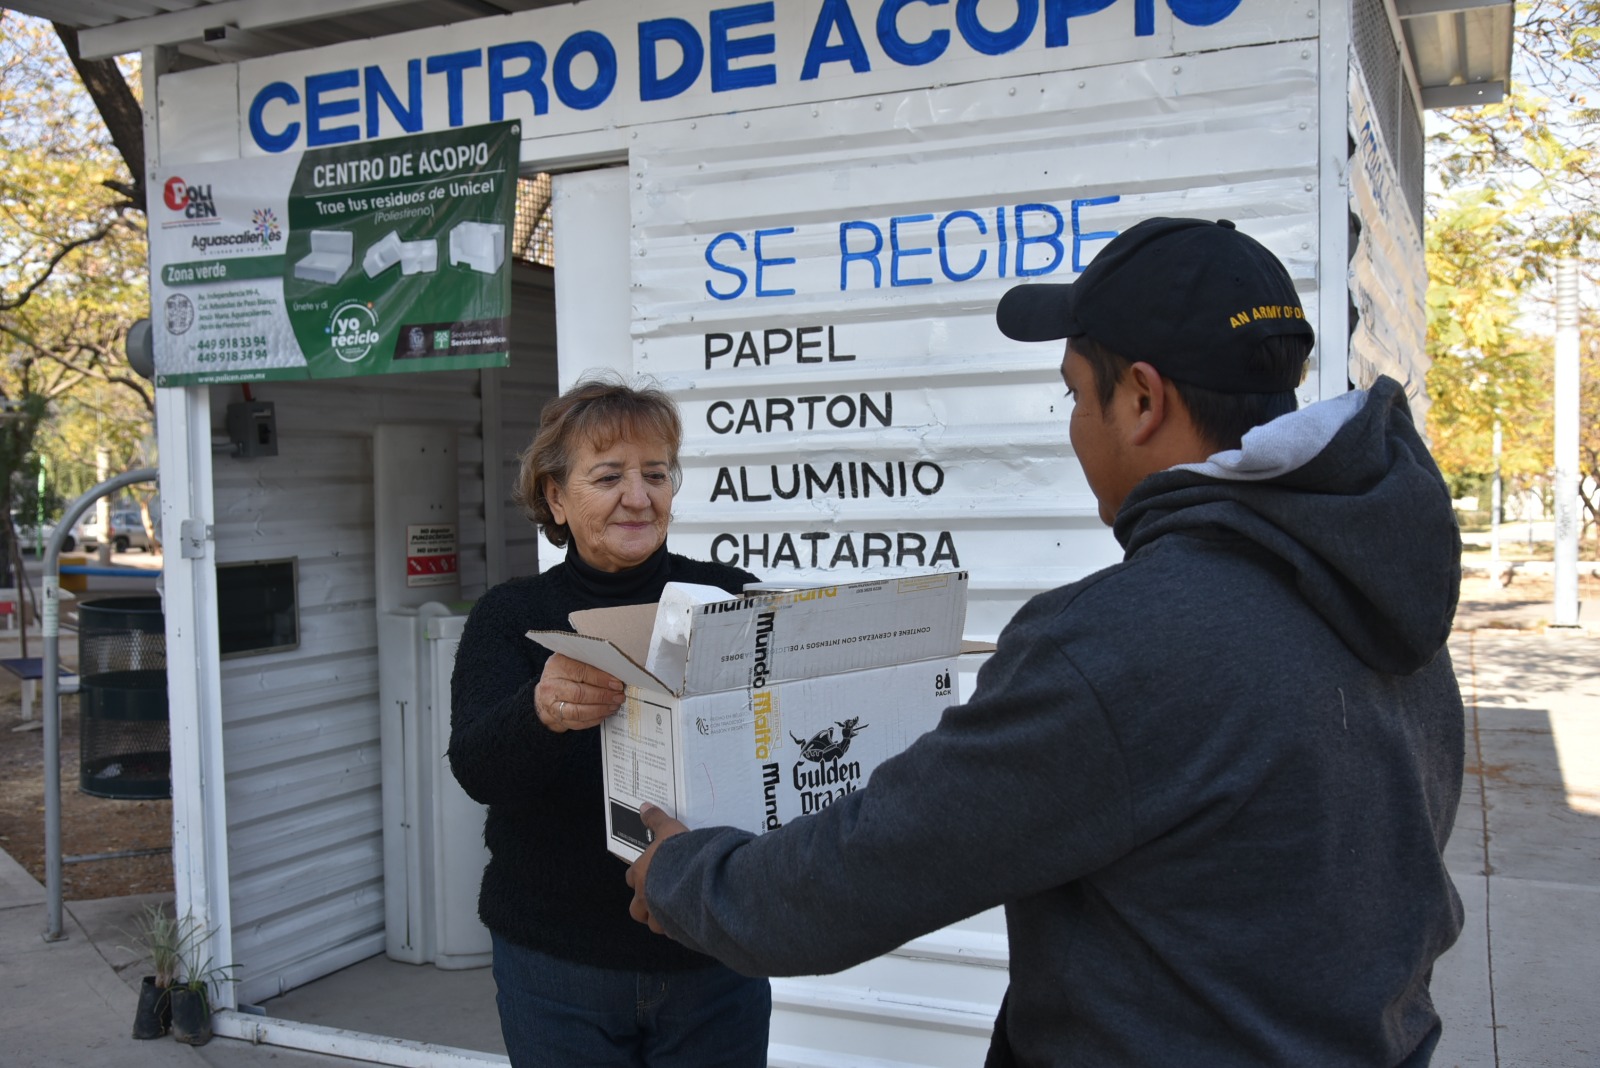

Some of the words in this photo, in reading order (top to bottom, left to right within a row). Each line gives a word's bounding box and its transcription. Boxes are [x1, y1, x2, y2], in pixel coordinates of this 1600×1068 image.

[249, 30, 618, 152] CENTRO
[639, 8, 777, 101] DE
[313, 157, 384, 188] CENTRO
[390, 154, 414, 179] DE
[419, 142, 488, 175] ACOPIO
[172, 183, 212, 205] POLI
[316, 200, 345, 216] Trae
[349, 198, 368, 212] tus
[371, 191, 426, 210] residuos
[428, 186, 445, 199] de
[449, 178, 495, 198] Unicel
[185, 202, 217, 219] CEN
[374, 204, 435, 225] (Poliestireno)
[705, 227, 796, 300] SE
[839, 195, 1121, 290] RECIBE
[168, 266, 194, 282] Zona
[196, 262, 227, 279] verde
[315, 303, 320, 311] y
[1229, 311, 1251, 329] AN
[1252, 305, 1282, 320] ARMY
[1283, 305, 1293, 318] OF
[337, 317, 360, 335] yo
[197, 339, 216, 350] 449
[219, 338, 238, 349] 918
[240, 337, 252, 347] 33
[255, 336, 267, 346] 94
[331, 330, 380, 348] reciclo
[451, 338, 481, 347] Servicios
[482, 336, 507, 345] Público
[705, 325, 856, 370] PAPEL
[197, 352, 216, 363] 449
[219, 351, 238, 362] 918
[240, 350, 252, 360] 34
[255, 349, 268, 360] 94
[706, 392, 893, 435] CARTON
[710, 461, 945, 502] ALUMINIO
[710, 531, 960, 569] CHATARRA
[841, 637, 857, 645] CON
[858, 632, 892, 643] CERVEZAS
[898, 626, 931, 637] CONTIENE
[753, 612, 775, 689] Mundo
[806, 638, 840, 650] INTENSOS
[935, 675, 944, 690] 8
[935, 690, 952, 698] PACK
[792, 755, 861, 791] Gulden
[762, 762, 782, 831] Mund
